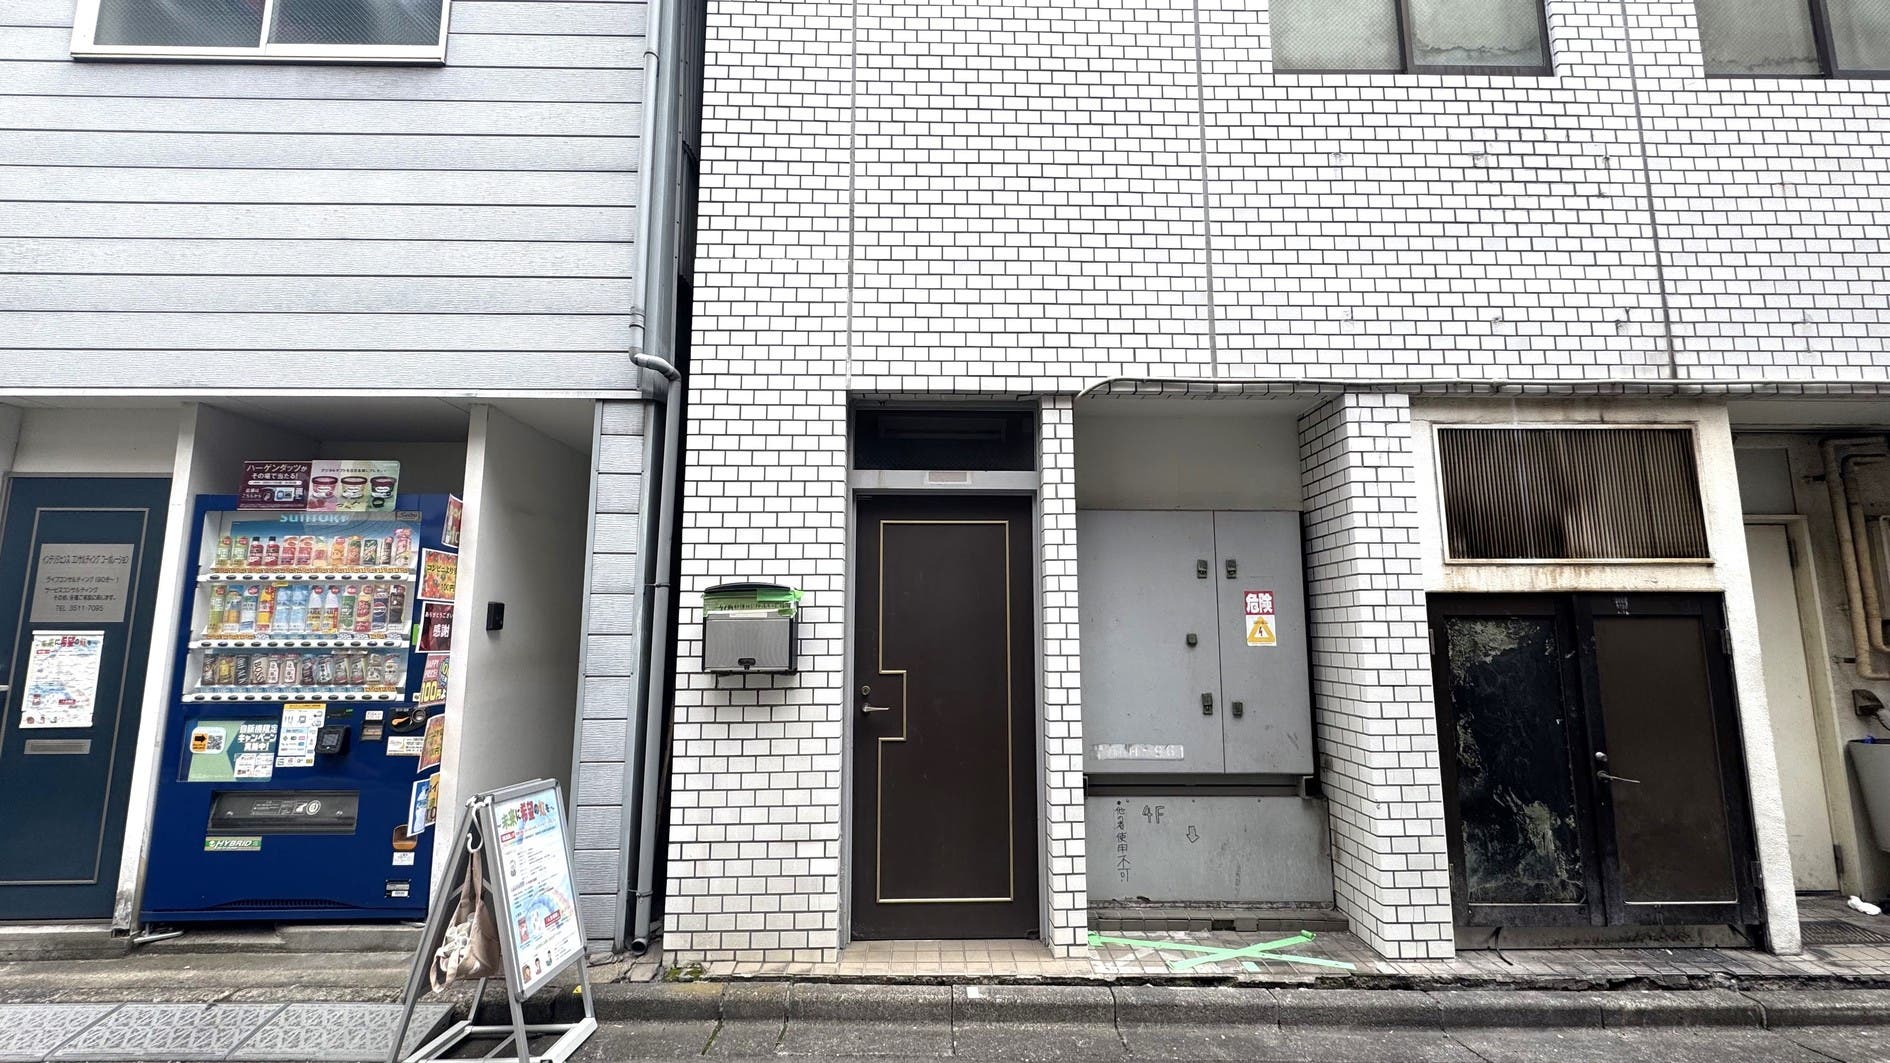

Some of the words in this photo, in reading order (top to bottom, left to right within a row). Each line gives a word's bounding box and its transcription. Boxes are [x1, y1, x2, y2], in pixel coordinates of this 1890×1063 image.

[246, 464, 308, 473] ハーゲンダッツが
[1246, 592, 1273, 614] 危険
[432, 623, 450, 638] 感謝
[238, 734, 278, 743] キャンペーン
[1142, 805, 1165, 824] 4F
[215, 840, 253, 849] HYBRID
